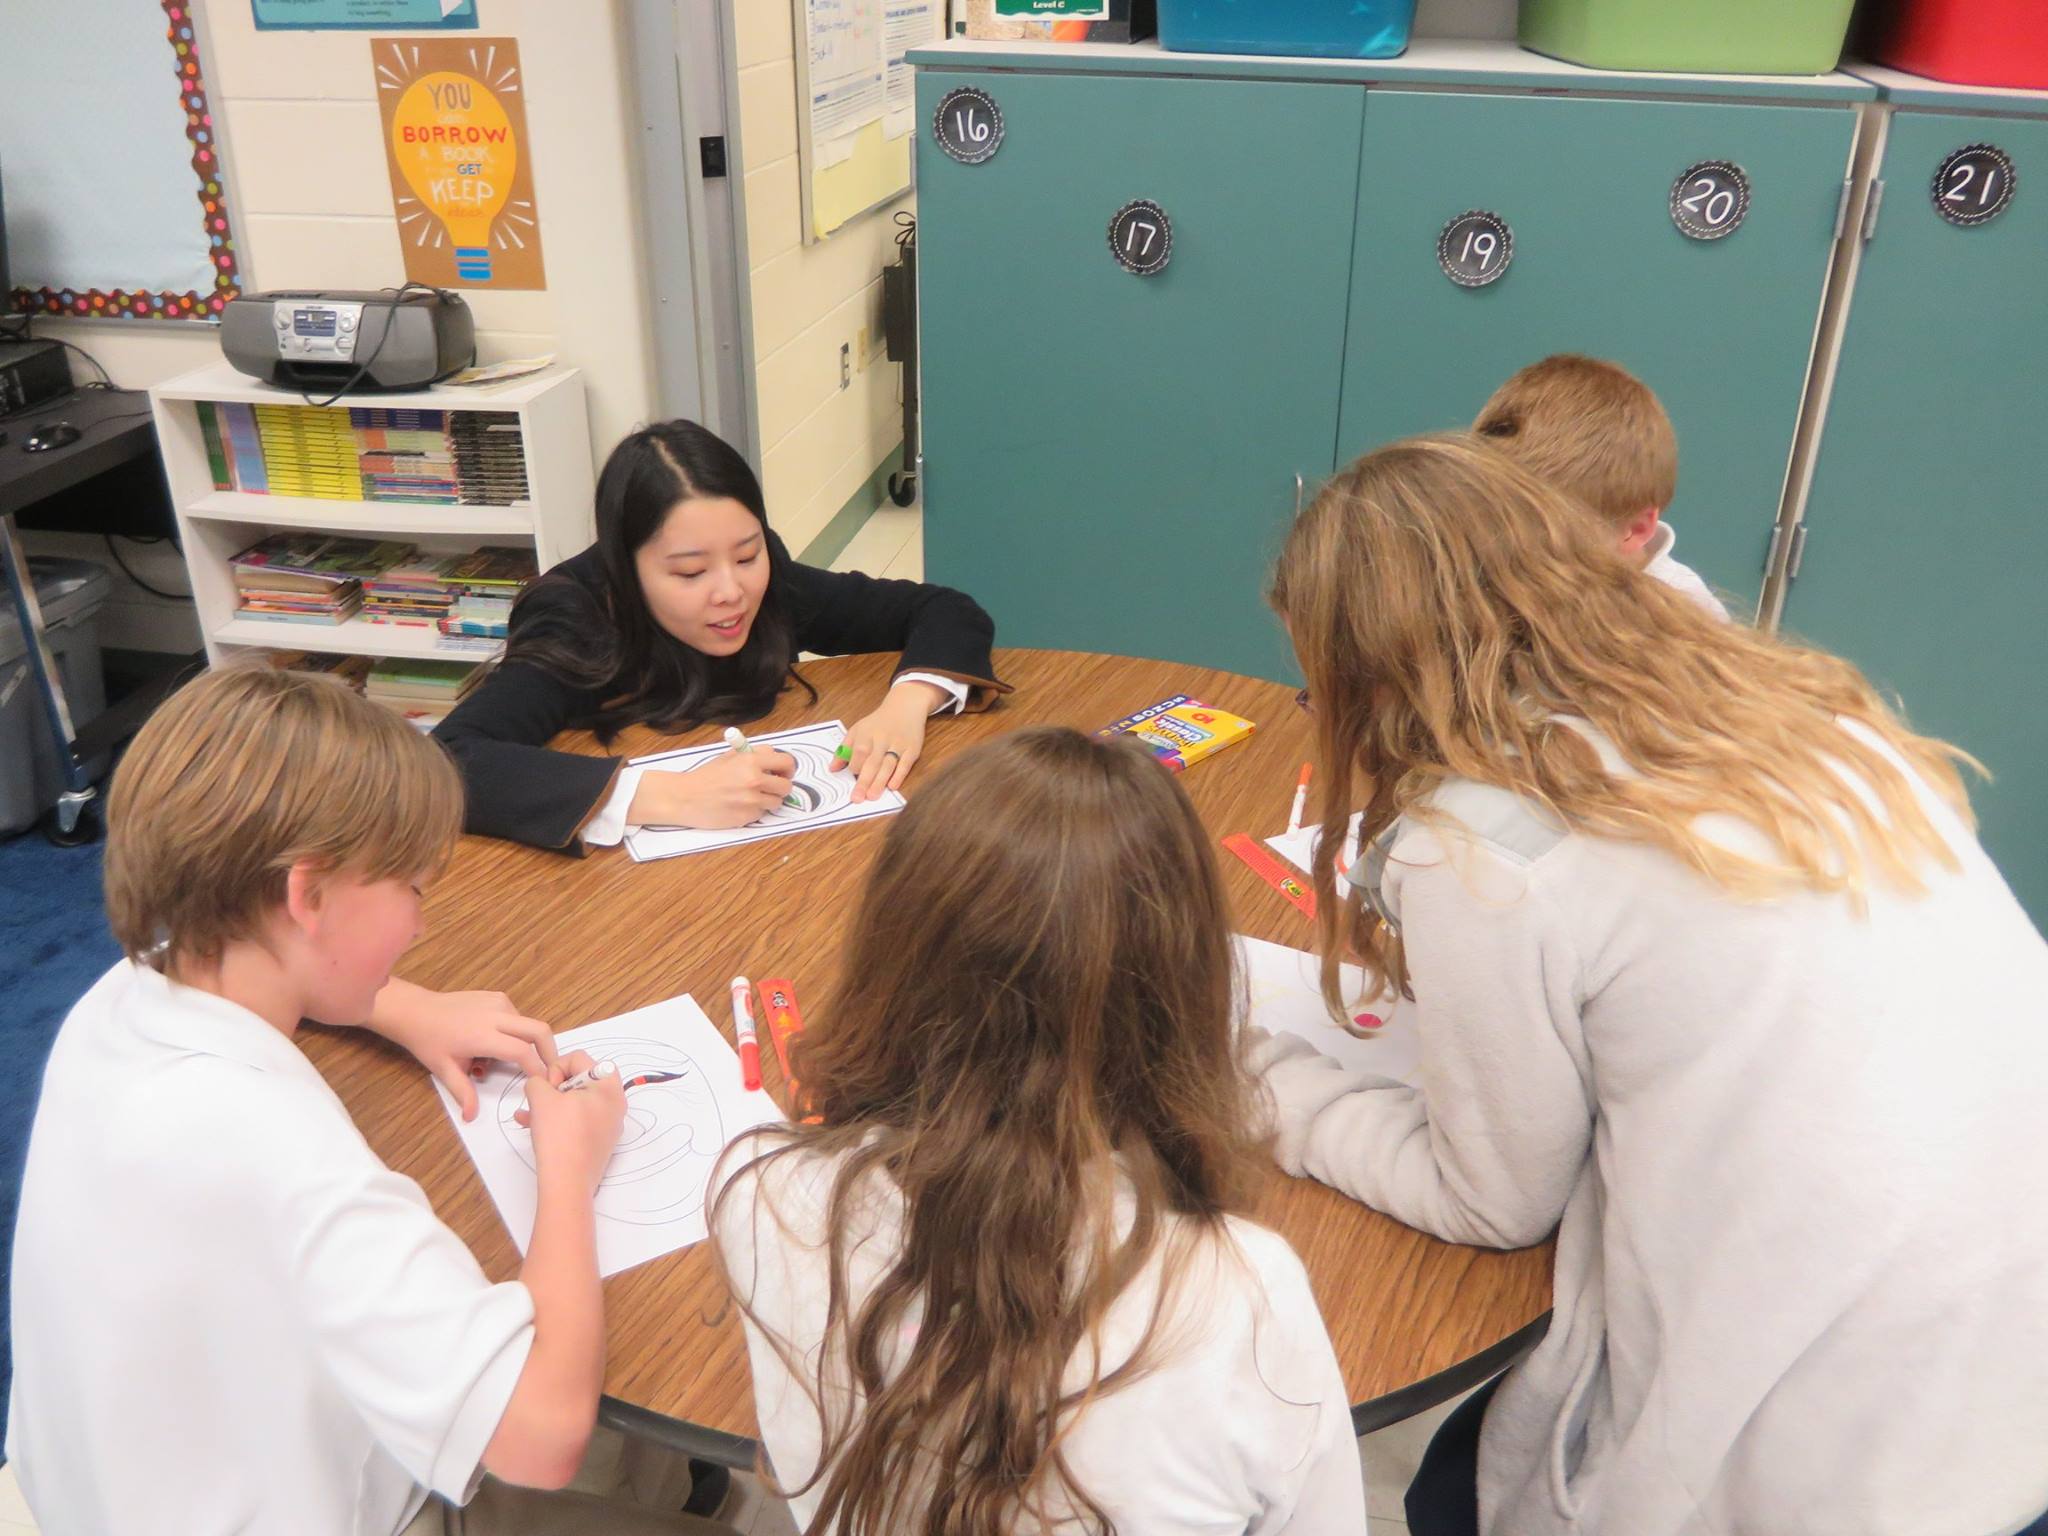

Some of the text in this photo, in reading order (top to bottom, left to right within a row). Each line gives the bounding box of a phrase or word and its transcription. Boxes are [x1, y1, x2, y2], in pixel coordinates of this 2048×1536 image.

[1033, 1, 1056, 9] Level
[427, 83, 472, 111] YOU
[402, 126, 507, 144] BORROW
[956, 108, 989, 142] 16
[457, 163, 482, 175] GET
[430, 178, 495, 206] KEEP
[1945, 164, 1996, 205] 21
[1682, 178, 1734, 225] 20
[1126, 221, 1157, 256] 17
[1460, 231, 1497, 270] 19
[1132, 696, 1186, 723] BONUS
